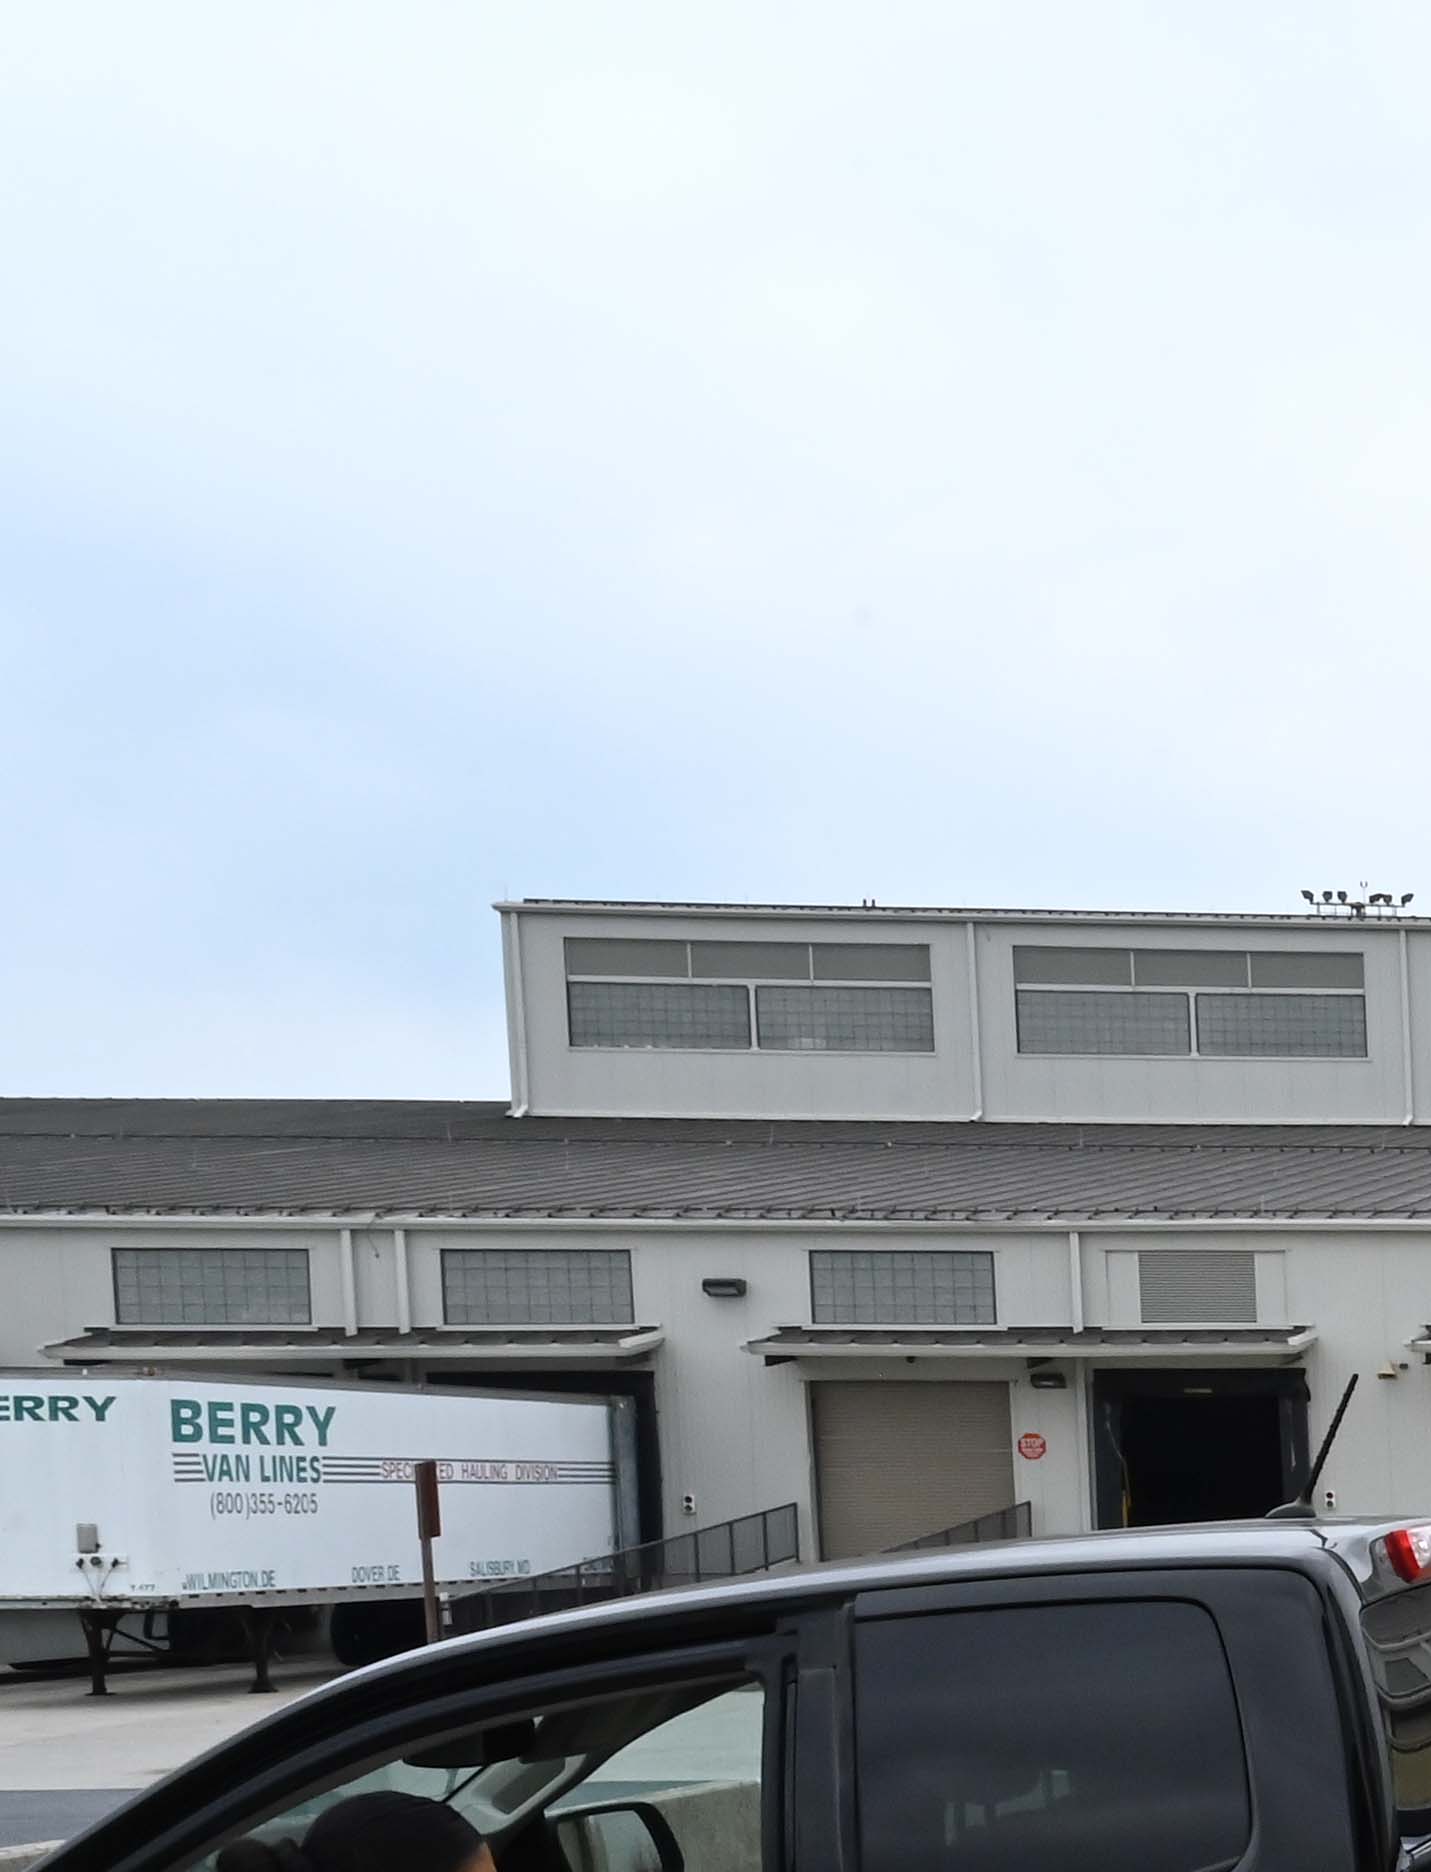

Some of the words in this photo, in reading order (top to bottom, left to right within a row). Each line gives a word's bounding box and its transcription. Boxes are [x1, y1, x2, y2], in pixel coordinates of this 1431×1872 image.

[170, 1399, 336, 1447] BERRY
[202, 1453, 250, 1482] VAN
[259, 1455, 322, 1484] LINES
[461, 1462, 508, 1480] HAULING
[515, 1463, 558, 1480] DIVISION
[210, 1491, 318, 1519] (800)355-6205
